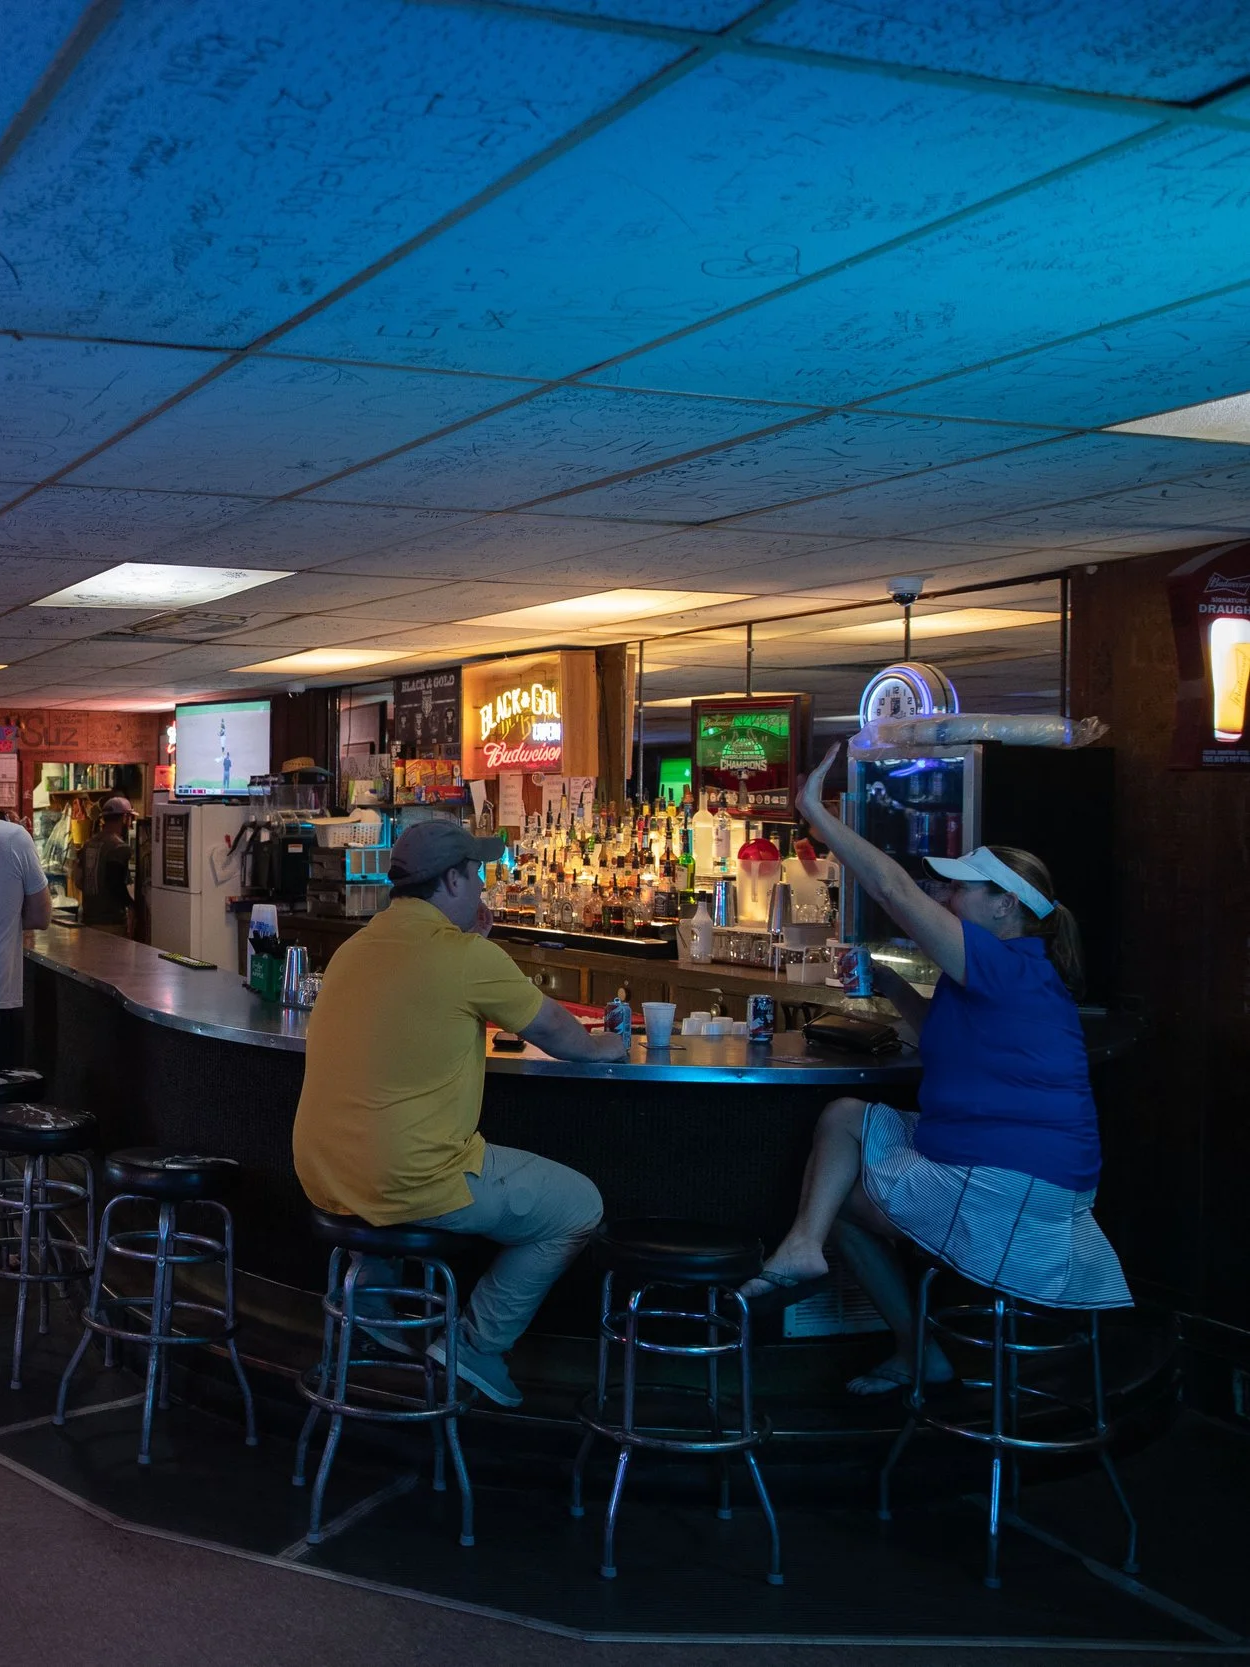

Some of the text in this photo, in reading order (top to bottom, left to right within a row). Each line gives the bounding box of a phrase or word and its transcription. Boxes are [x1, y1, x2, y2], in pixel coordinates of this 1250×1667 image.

[1198, 604, 1250, 614] DRAUGH
[401, 678, 426, 693] BLACK
[433, 674, 455, 688] GOLD
[479, 687, 522, 741] BLACK
[531, 683, 561, 718] GOL
[720, 760, 768, 772] CHAMPIONS
